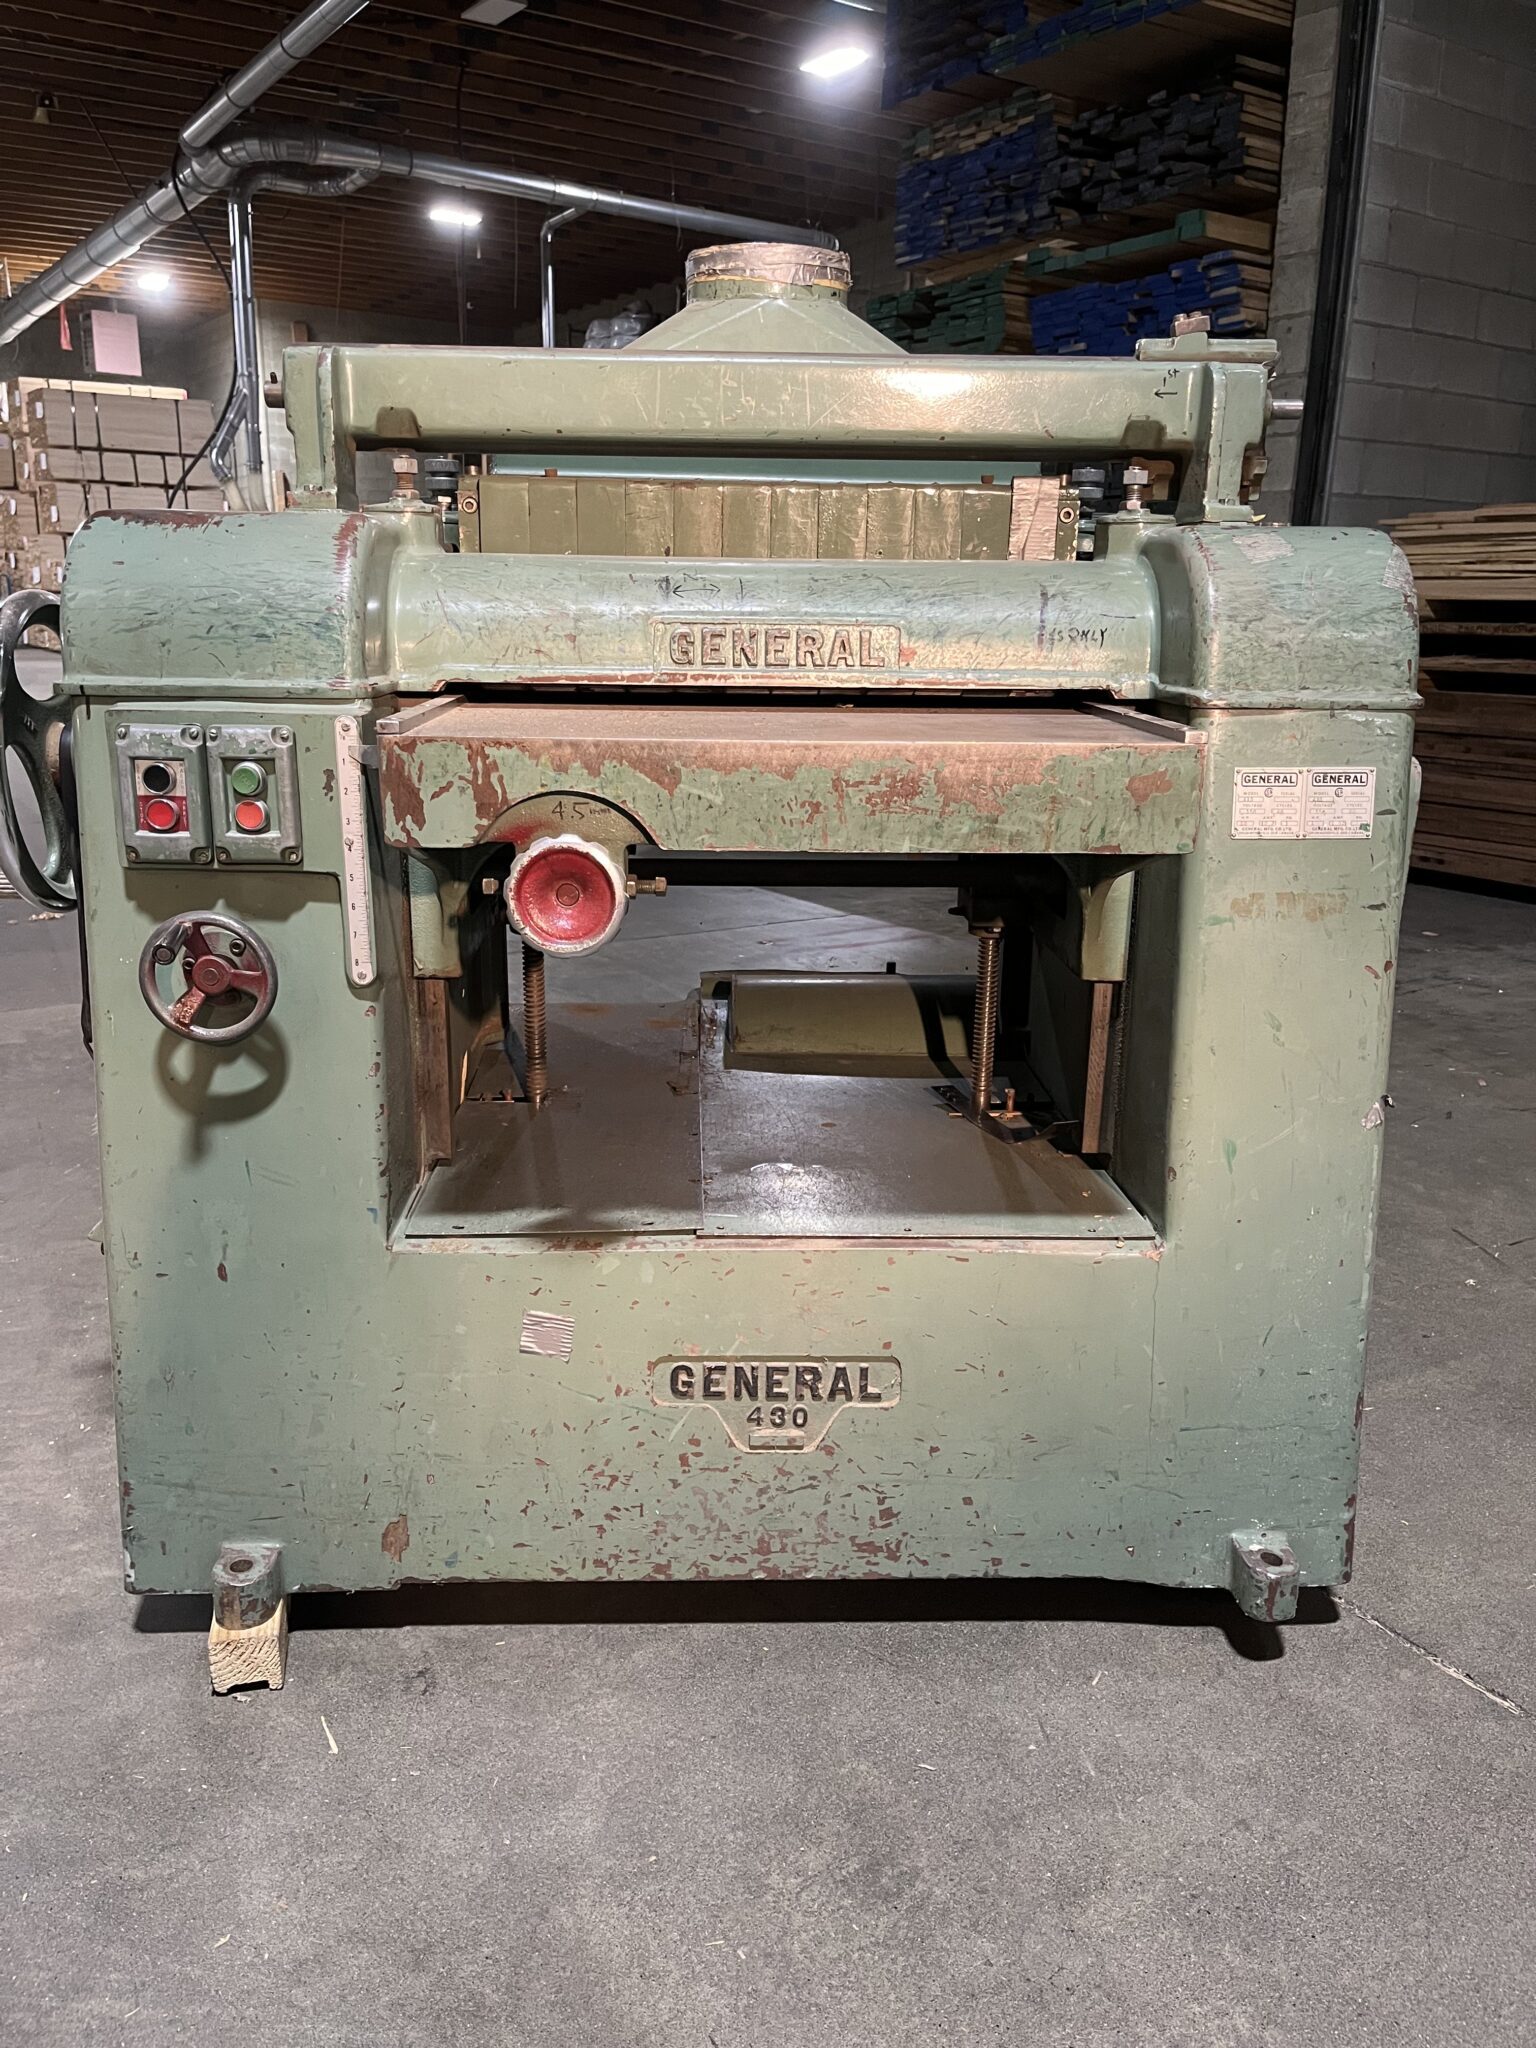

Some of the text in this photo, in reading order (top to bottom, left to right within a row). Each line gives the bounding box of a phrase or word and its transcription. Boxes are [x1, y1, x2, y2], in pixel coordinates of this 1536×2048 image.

[670, 627, 885, 667] GENERAL
[1243, 774, 1296, 784] GENERAL
[1314, 774, 1366, 784] GENERAL
[344, 787, 349, 796] 2
[346, 817, 351, 826] 3
[349, 873, 354, 882] 5
[351, 902, 356, 911] 6
[353, 930, 358, 940] 7
[354, 958, 360, 967] 8
[670, 1363, 882, 1401] GENERAL
[747, 1405, 809, 1429] 430
